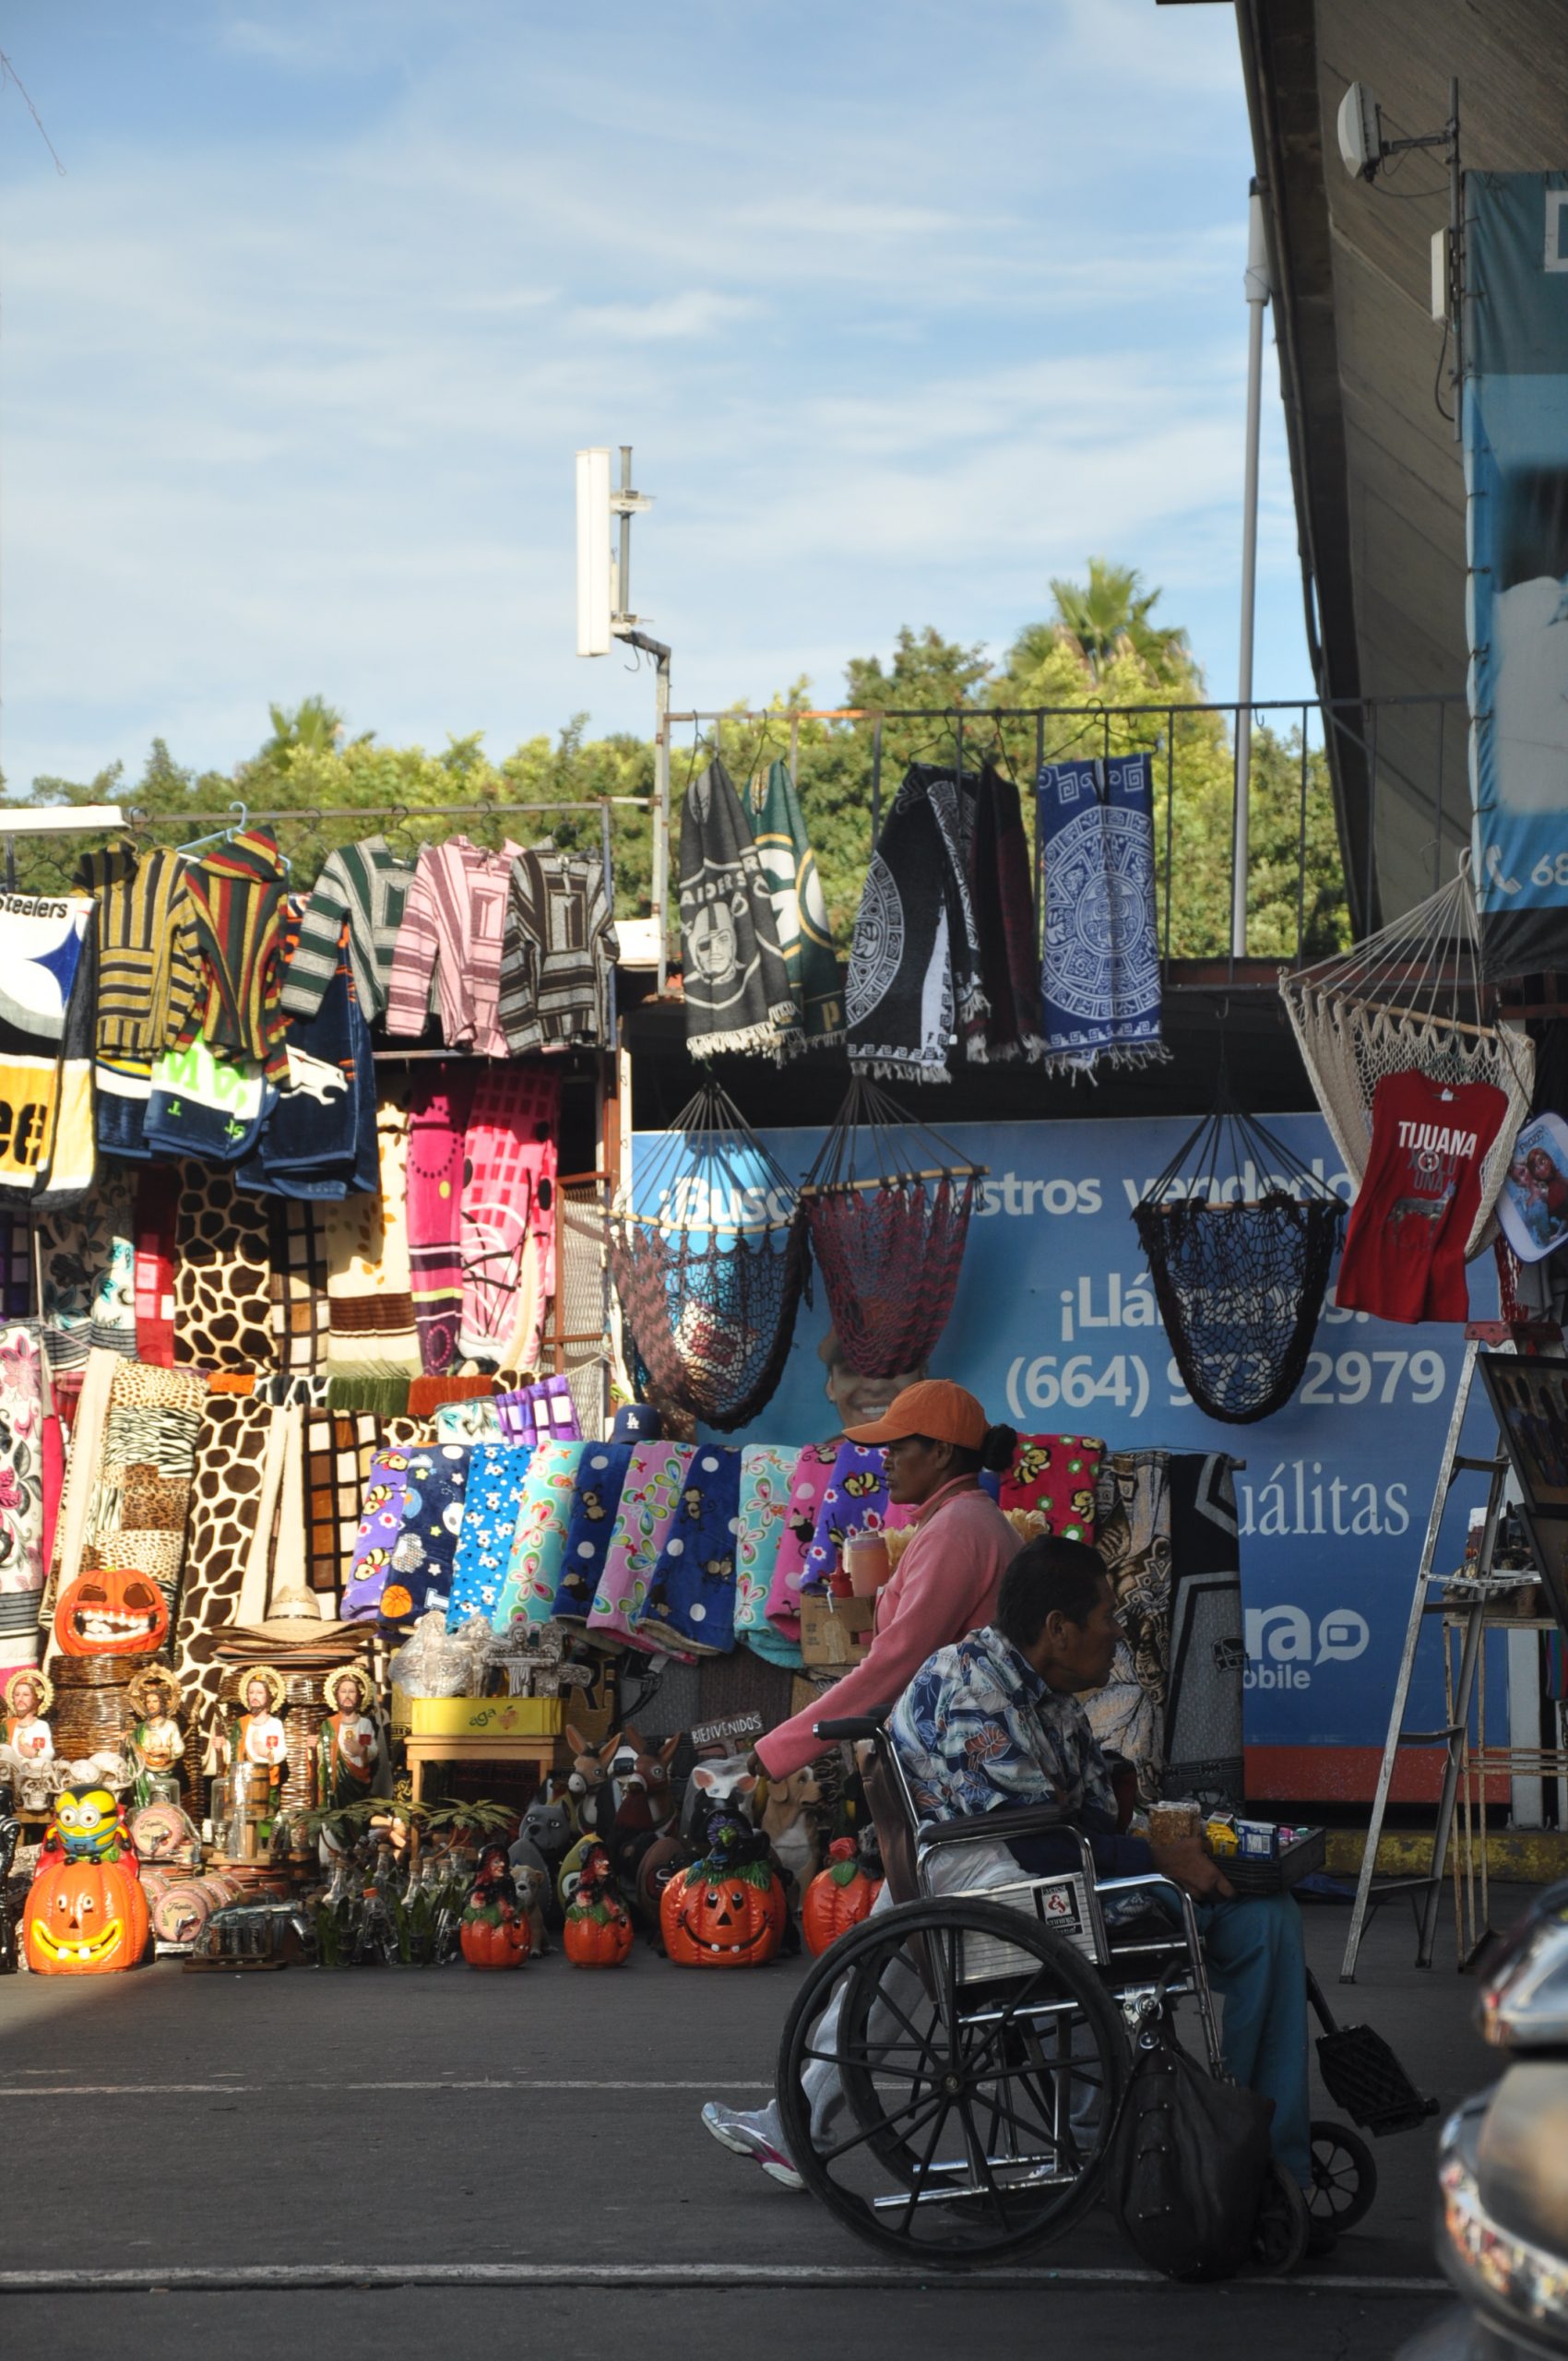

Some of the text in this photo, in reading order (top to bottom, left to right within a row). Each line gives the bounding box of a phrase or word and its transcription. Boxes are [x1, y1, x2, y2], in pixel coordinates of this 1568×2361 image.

[680, 870, 747, 908] AIDERS
[1398, 1121, 1478, 1161] TIJUANA
[1006, 1354, 1150, 1419] (664)
[1300, 1349, 1446, 1405] 2979
[1238, 1459, 1410, 1536] uálitas
[1242, 1663, 1312, 1691] obile
[691, 1713, 763, 1744] BIENVENIDOS
